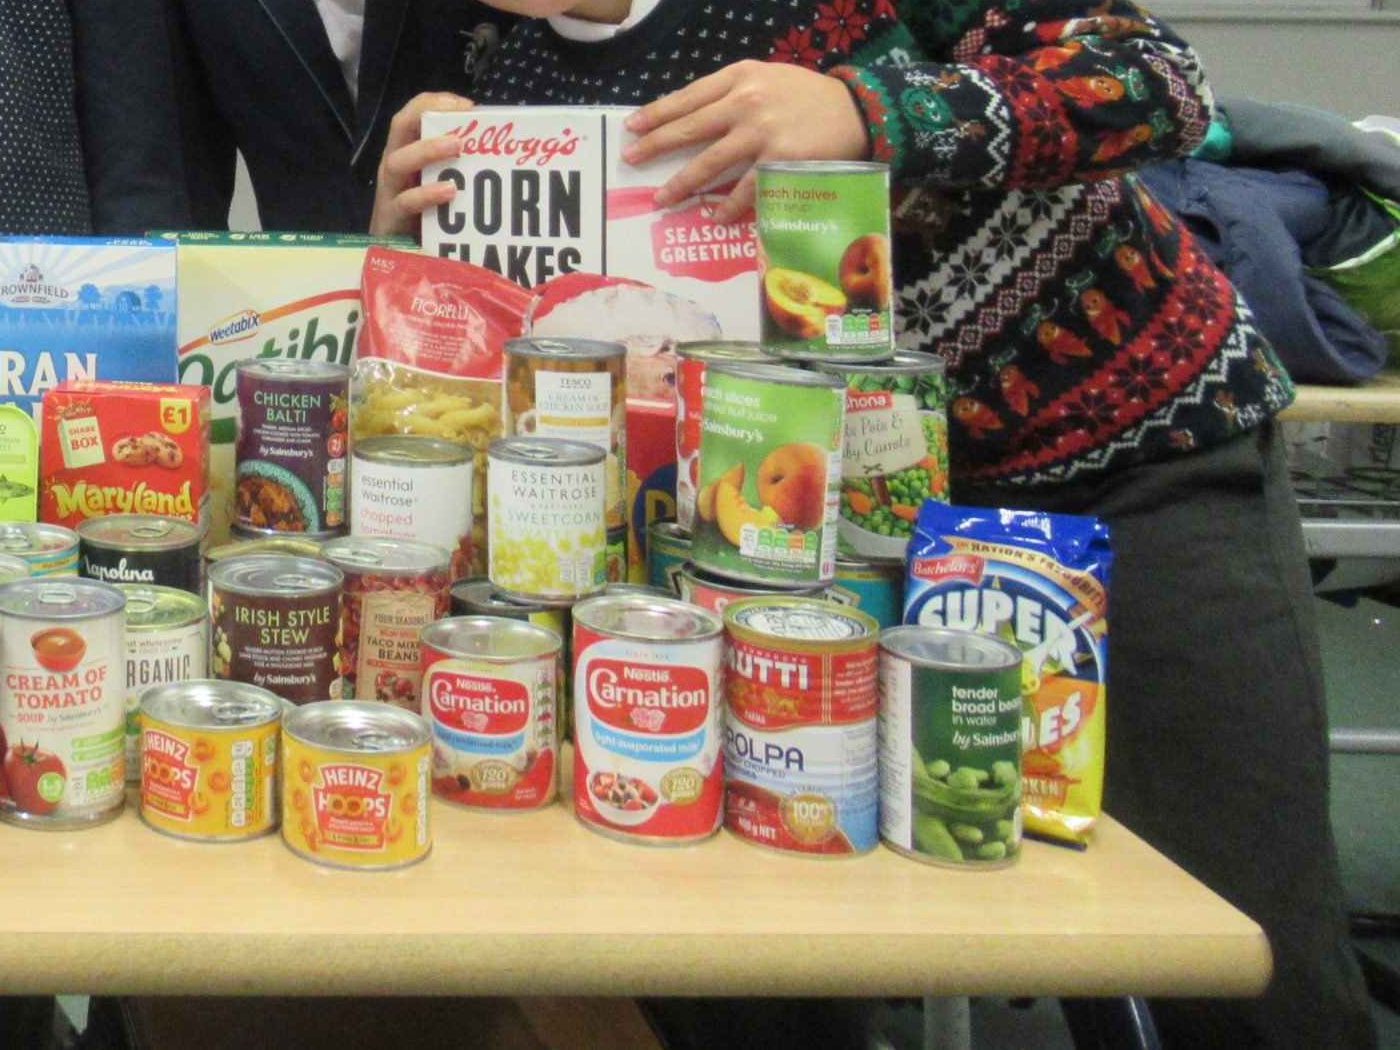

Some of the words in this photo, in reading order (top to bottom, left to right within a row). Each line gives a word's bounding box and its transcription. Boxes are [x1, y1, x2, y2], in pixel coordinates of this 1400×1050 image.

[437, 168, 581, 238] CORN
[793, 188, 837, 200] halves
[665, 221, 759, 244] SEASON'S
[770, 218, 838, 233] Sainsbury's
[660, 241, 757, 264] GREETING
[370, 256, 396, 270] M&S
[411, 297, 470, 321] FIORELLI
[210, 312, 260, 343] Weetabix
[560, 378, 592, 388] TESCO
[254, 391, 321, 408] CHICKEN
[162, 406, 188, 425] £1
[267, 408, 306, 423] BALTI
[69, 425, 95, 434] SHARE
[71, 436, 98, 451] BOX
[260, 445, 269, 457] by
[270, 447, 313, 459] Sainsbury's
[361, 474, 413, 492] essential
[512, 470, 597, 485] ESSENTIAL
[51, 480, 195, 519] Maryland
[361, 489, 413, 507] Waitrose
[512, 486, 597, 500] WAITROSE
[360, 508, 413, 526] chopped
[507, 509, 600, 526] SWEETCORN
[971, 542, 1035, 562] NATION'S
[235, 606, 280, 627] IRISH
[288, 606, 330, 627] STYLE
[261, 628, 309, 646] STEW
[918, 588, 1077, 676] SUPER
[366, 636, 395, 649] TACO
[378, 649, 420, 662] BEANS
[6, 673, 80, 691] CREAM
[85, 665, 107, 684] OF
[126, 654, 190, 689] RGANIC
[254, 673, 265, 685] by
[267, 673, 316, 685] Sainsbury's
[624, 666, 670, 683] Nestlé
[456, 677, 493, 693] Nestlé
[589, 667, 706, 708] Carnation
[952, 685, 999, 700] tender
[14, 686, 102, 709] TOMATO
[431, 678, 526, 714] Carnation
[952, 698, 995, 713] broad
[17, 713, 44, 723] SOUP
[952, 715, 963, 725] in
[966, 715, 997, 727] water
[147, 732, 186, 761] HEINZ
[618, 736, 676, 754] evaporated
[678, 739, 699, 752] milk
[726, 727, 804, 771] POLPA
[953, 731, 971, 749] by
[324, 768, 379, 790] HEINZ
[318, 793, 386, 818] HOOPS
[759, 823, 777, 840] NET
